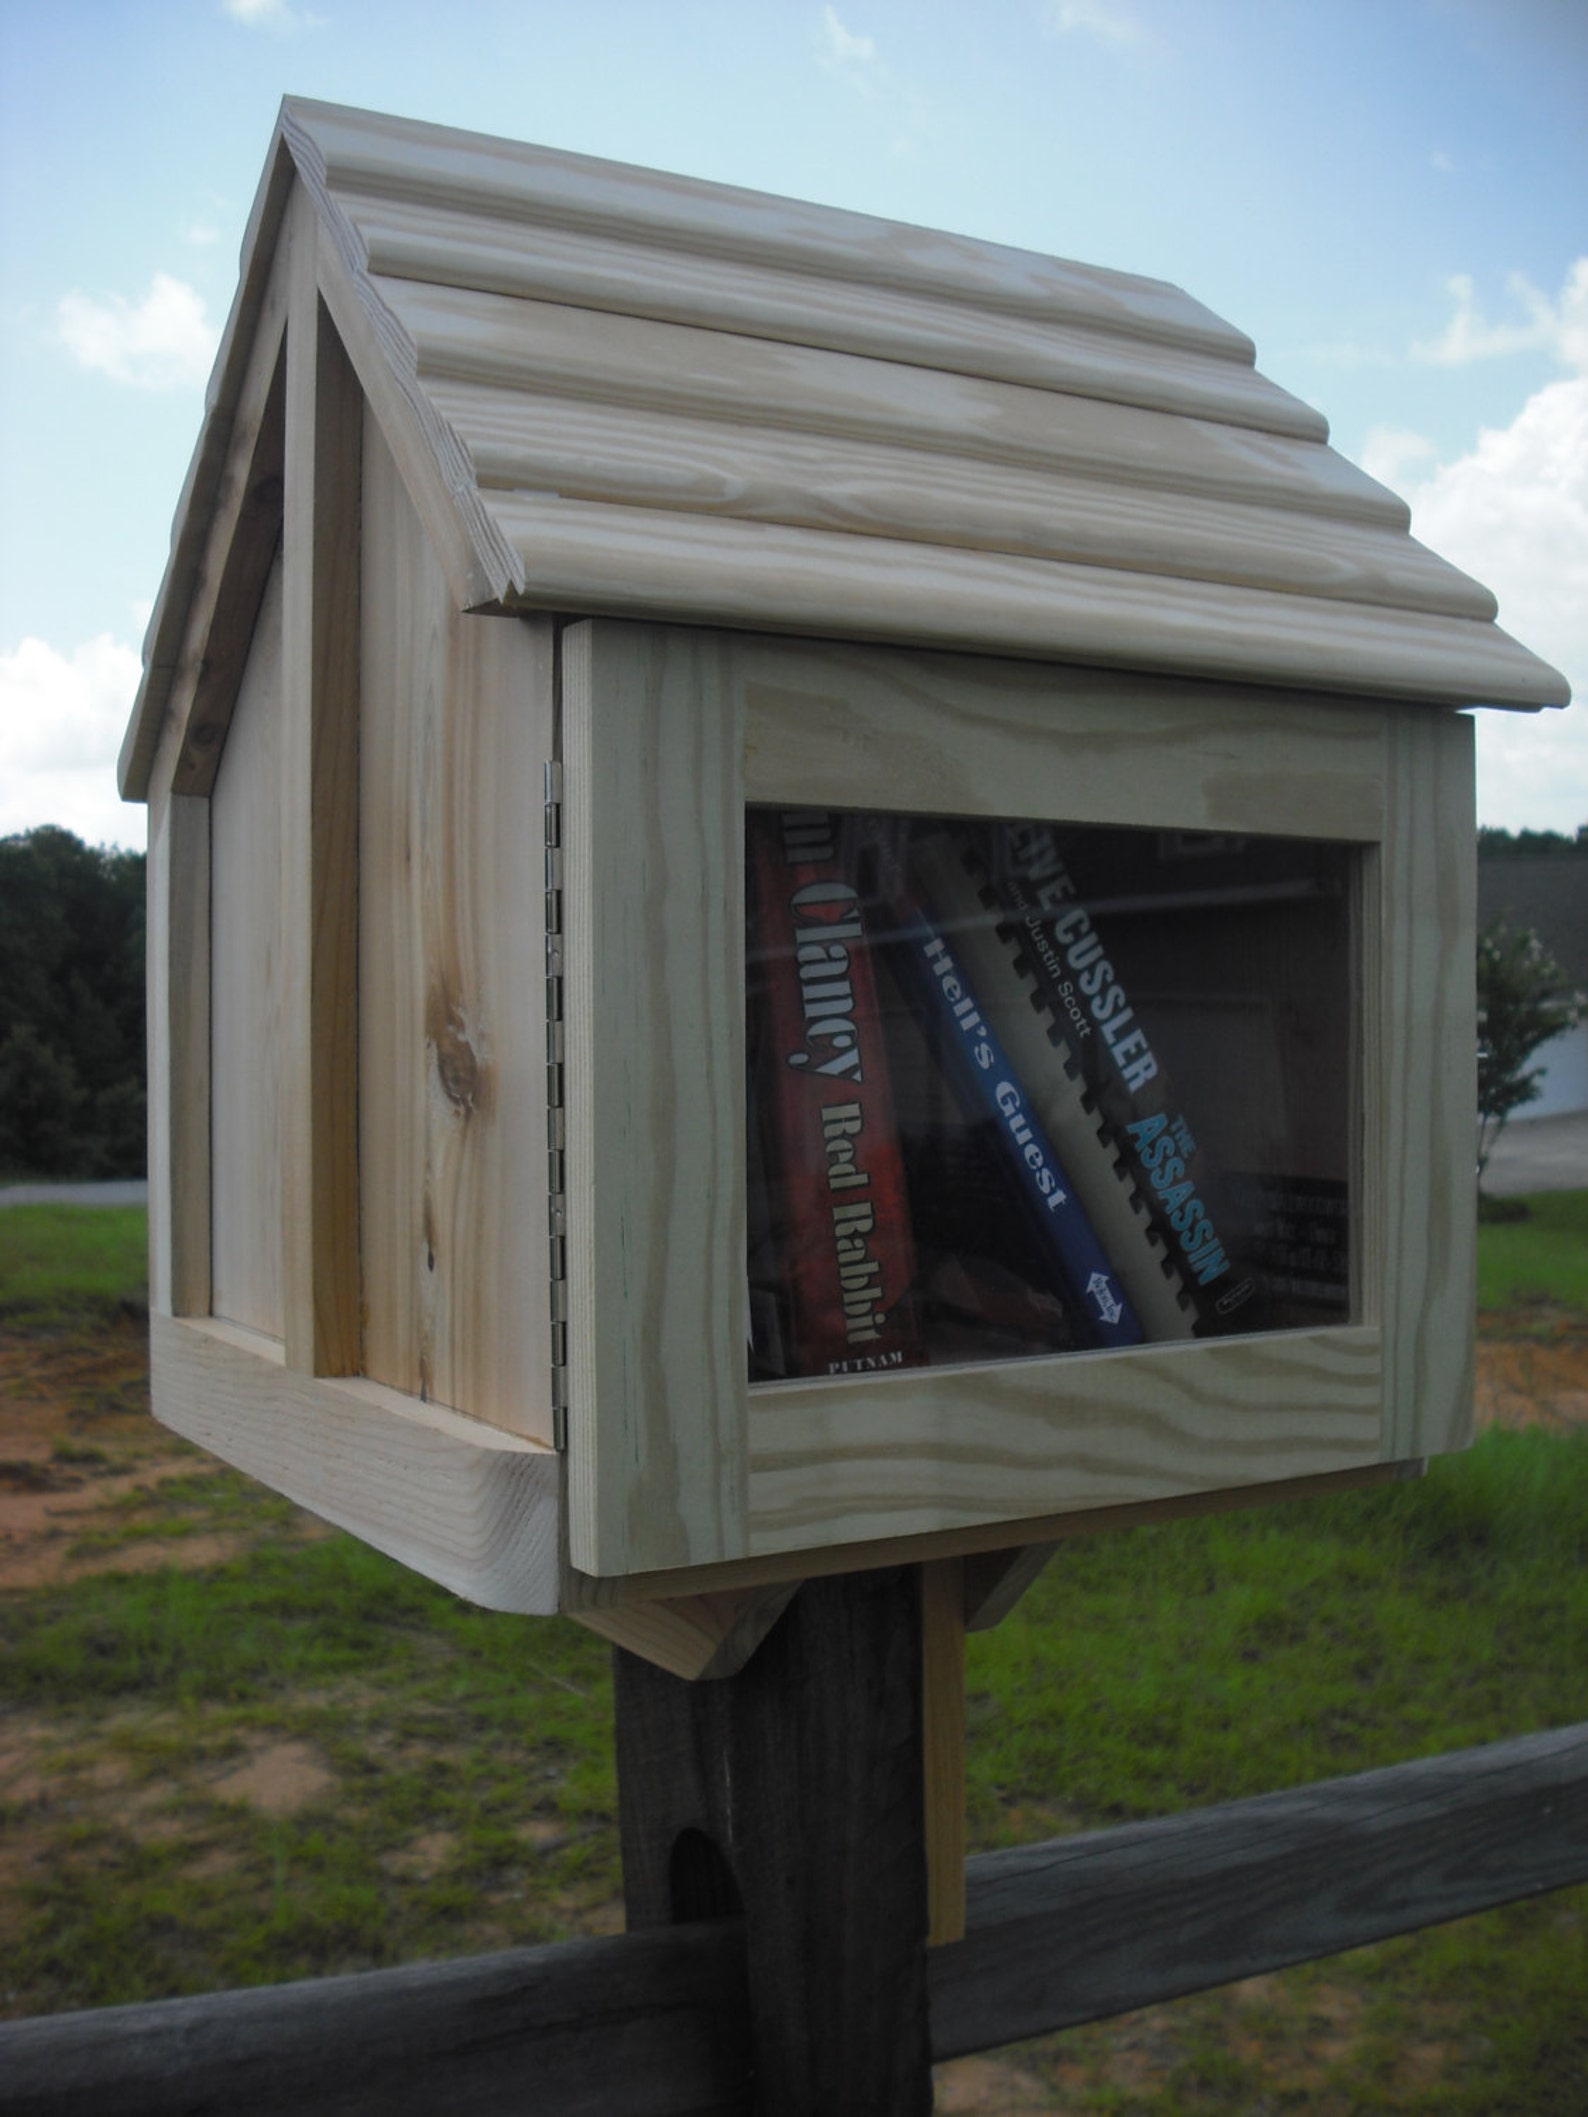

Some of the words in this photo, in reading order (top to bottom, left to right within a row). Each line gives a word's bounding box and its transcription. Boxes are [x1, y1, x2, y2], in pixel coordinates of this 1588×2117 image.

[787, 881, 863, 1083] Clancy
[1025, 913, 1061, 979] Justin
[1058, 981, 1092, 1038] Scott
[1055, 908, 1158, 1093] CUSSLER
[821, 1102, 870, 1190] Red
[923, 937, 995, 1070] Hell's
[995, 1081, 1068, 1212] Guest
[1170, 1113, 1196, 1158] THE
[1126, 1112, 1230, 1286] ASSASSIN
[832, 1201, 887, 1345] Rabbit
[828, 1350, 903, 1375] PUTNAM
